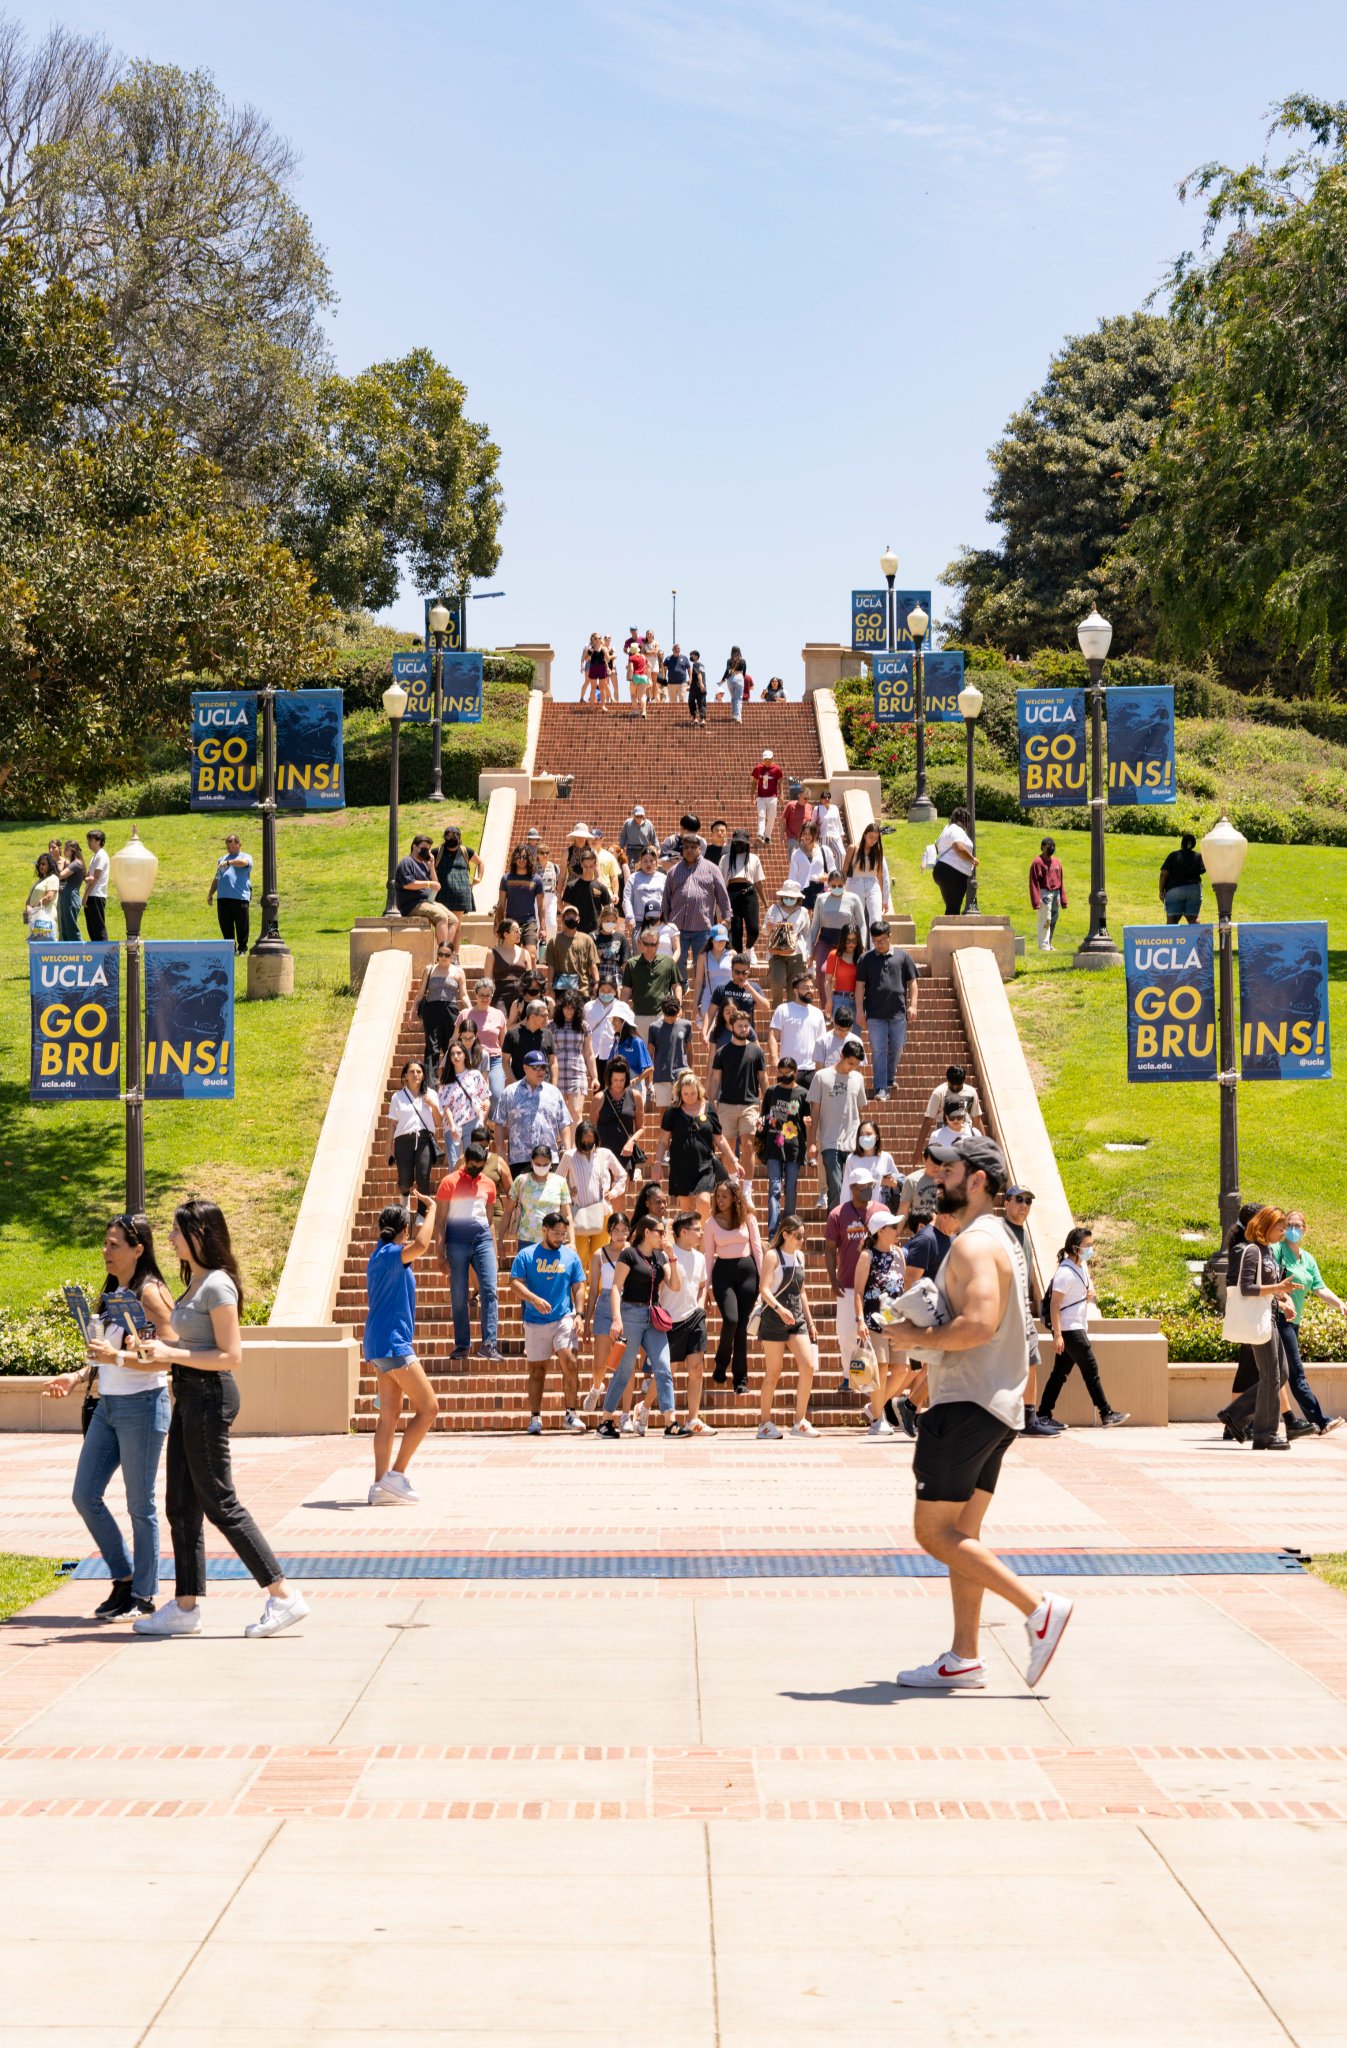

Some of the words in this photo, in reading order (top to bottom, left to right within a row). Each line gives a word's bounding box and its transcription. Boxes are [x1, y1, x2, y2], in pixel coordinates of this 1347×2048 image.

[856, 598, 882, 608] UCLA
[855, 613, 882, 628] GO
[855, 628, 886, 642] BRU
[897, 628, 929, 642] IN!
[397, 663, 427, 674] UCLA
[878, 663, 908, 674] UCLA
[399, 680, 427, 696] GO
[878, 680, 908, 696] GO
[442, 696, 480, 712] INS!
[878, 697, 914, 713] BRU
[925, 696, 960, 712] INS
[198, 708, 248, 726] UCLA
[1025, 706, 1076, 724] UCLA
[198, 737, 248, 764] GO
[1025, 734, 1076, 761] GO
[198, 766, 256, 792] BRU
[278, 764, 340, 790] INS!
[1026, 763, 1086, 790] BRU
[1108, 760, 1172, 788] INS!
[1134, 947, 1202, 970] UCLA
[41, 964, 108, 987] UCLA
[1134, 986, 1202, 1020] GO
[40, 1004, 108, 1038] GO
[1136, 1024, 1214, 1058] BRU
[1242, 1020, 1326, 1056] INS!
[40, 1042, 120, 1076] BRU
[146, 1040, 230, 1076] INS!
[1138, 1062, 1172, 1070] ucla.edu
[1300, 1058, 1324, 1066] @ucla
[202, 1078, 228, 1086] @ucla
